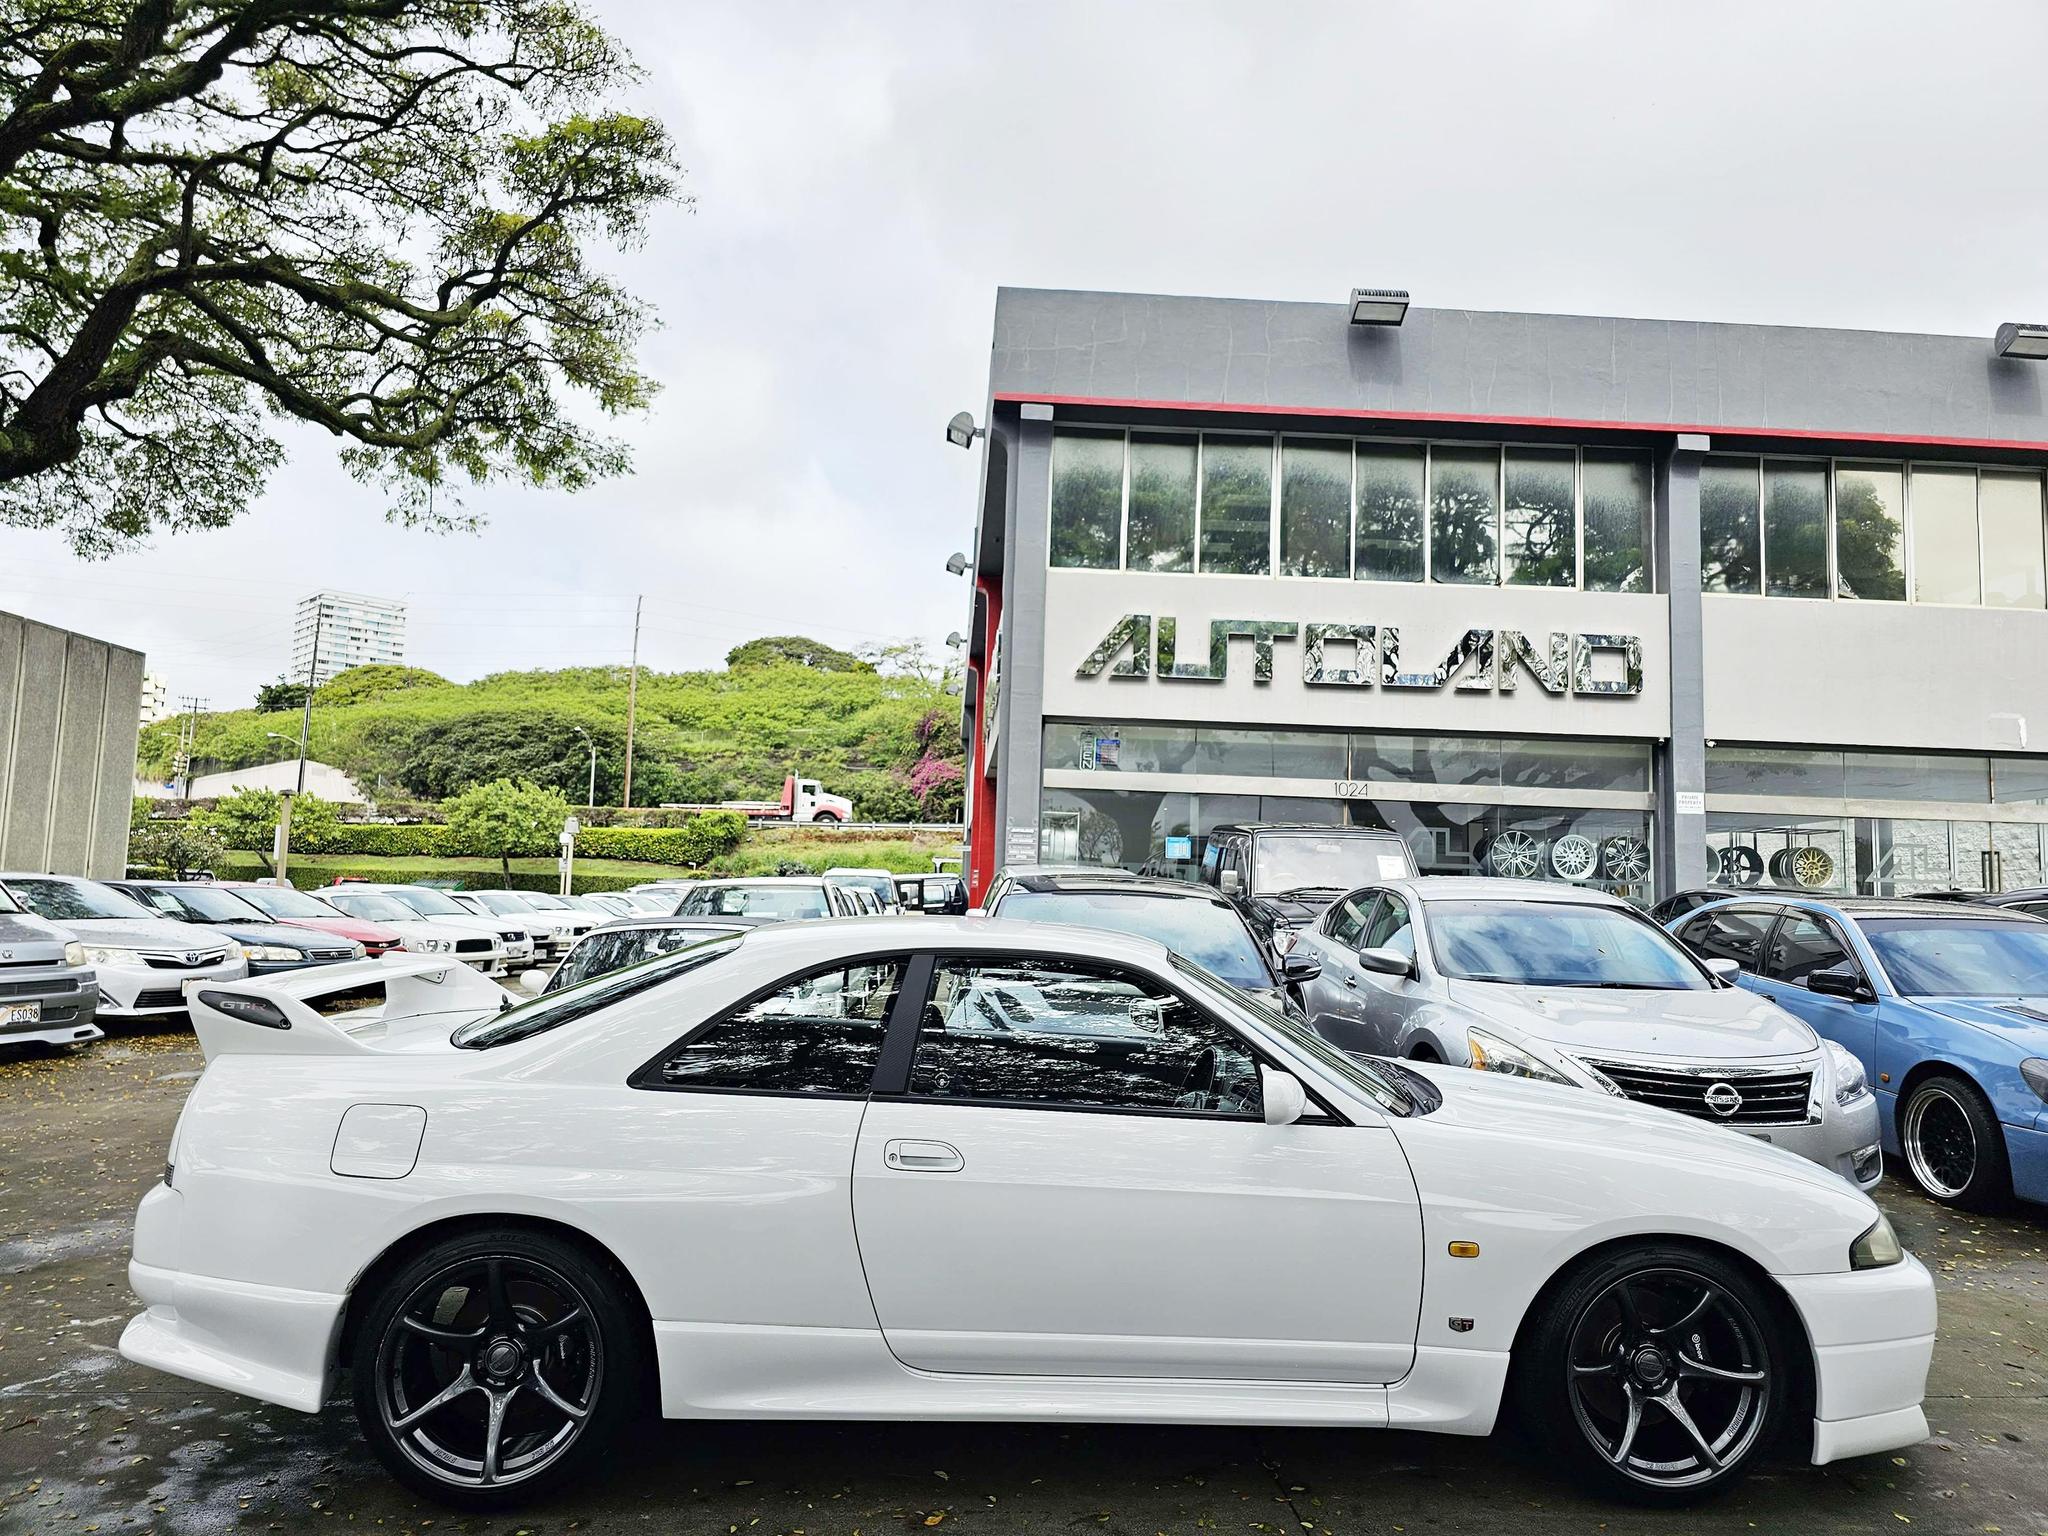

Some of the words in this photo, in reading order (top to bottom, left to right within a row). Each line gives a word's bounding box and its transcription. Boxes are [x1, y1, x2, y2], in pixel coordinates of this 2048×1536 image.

[1075, 614, 1644, 697] AUTOLAND
[1334, 782, 1368, 797] 1024
[1709, 1095, 1740, 1104] NISSAN
[1451, 1318, 1473, 1331] GT
